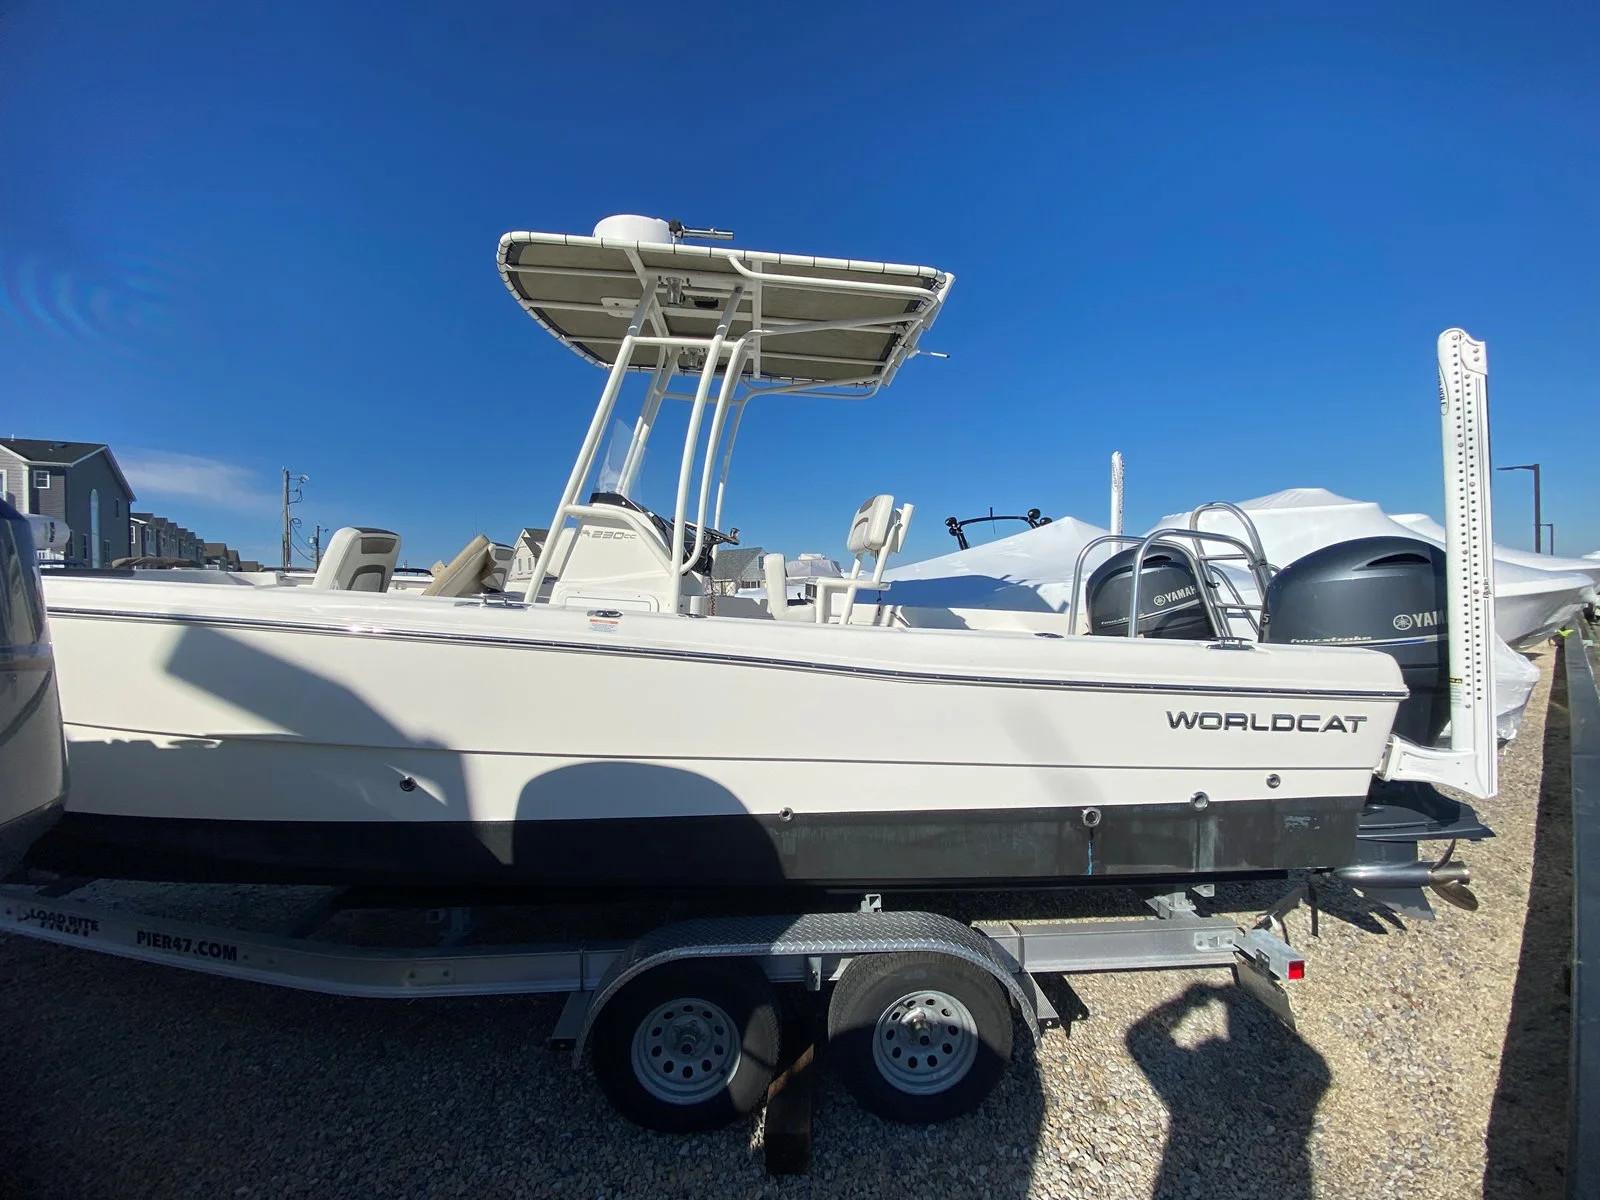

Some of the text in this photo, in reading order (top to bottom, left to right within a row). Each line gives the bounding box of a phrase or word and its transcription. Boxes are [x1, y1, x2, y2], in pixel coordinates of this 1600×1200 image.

[1164, 585, 1195, 602] YAMAH
[1166, 711, 1367, 733] WORLDCAT
[137, 931, 237, 960] PIER47.COM
